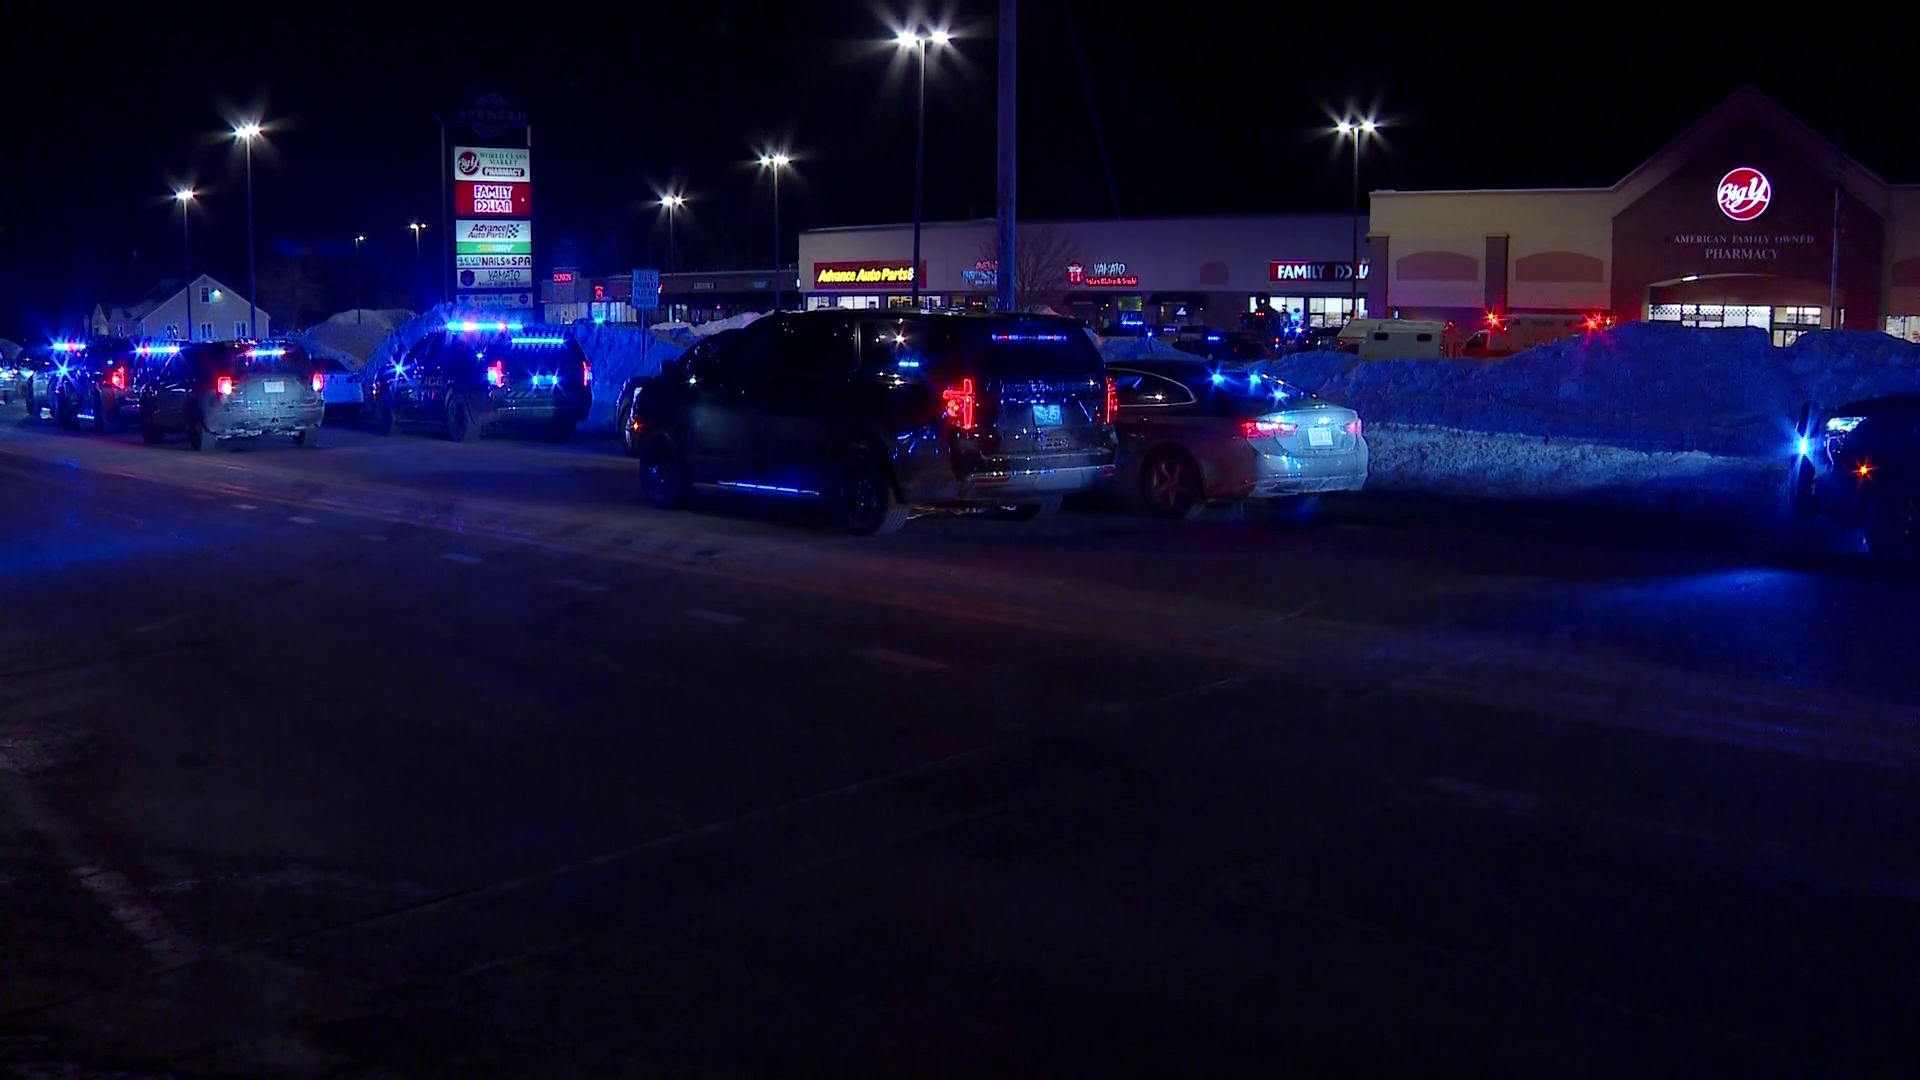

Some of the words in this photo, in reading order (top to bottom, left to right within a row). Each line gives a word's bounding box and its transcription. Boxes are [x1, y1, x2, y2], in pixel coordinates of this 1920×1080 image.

[474, 185, 513, 199] FAMILY
[472, 224, 506, 233] Advance
[467, 231, 486, 239] Auto
[486, 231, 506, 239] Parts
[1674, 235, 1727, 244] AMERICAN
[1732, 235, 1770, 244] FAMILY
[1774, 235, 1814, 244] OWNED
[1705, 249, 1778, 260] PHARMACY
[481, 257, 506, 266] NAILS
[511, 256, 531, 266] SPA
[818, 269, 857, 282] Advance
[856, 268, 881, 282] Auto
[881, 267, 908, 281] Parts
[1277, 264, 1325, 280] FAMILY
